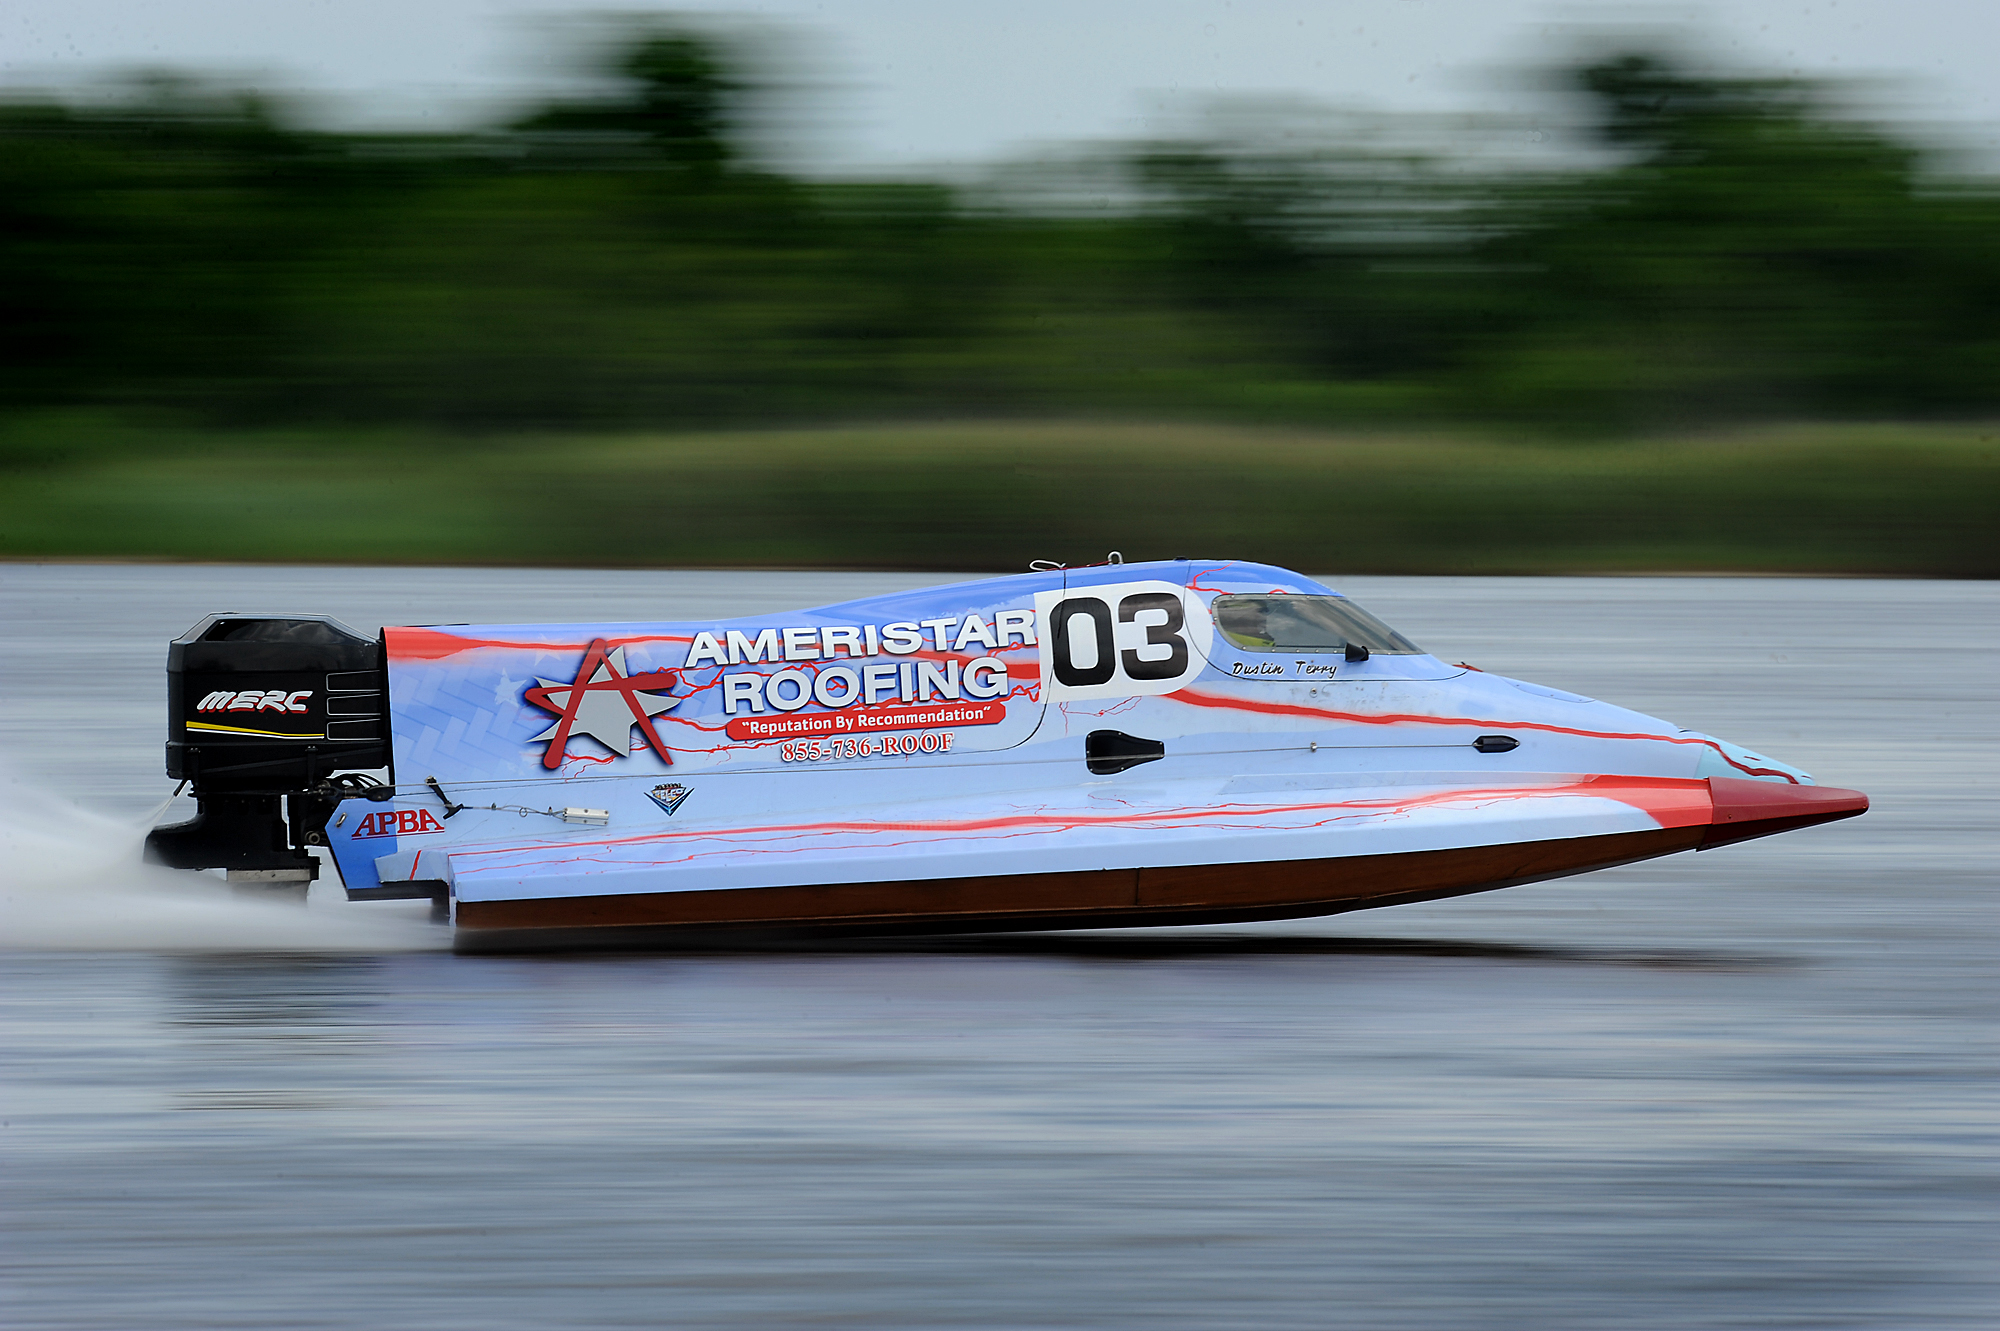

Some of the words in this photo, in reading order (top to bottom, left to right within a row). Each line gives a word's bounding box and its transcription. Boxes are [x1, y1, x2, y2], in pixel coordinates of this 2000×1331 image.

[684, 609, 1037, 668] AMERISTAR
[1049, 592, 1189, 687] 03
[1232, 661, 1284, 675] Dustin
[1295, 660, 1337, 679] Terry
[723, 656, 1009, 714] ROOFING
[197, 690, 313, 714] MERC
[836, 713, 854, 730] By
[781, 732, 954, 762] 855-736-ROOF
[351, 808, 445, 837] APBA
